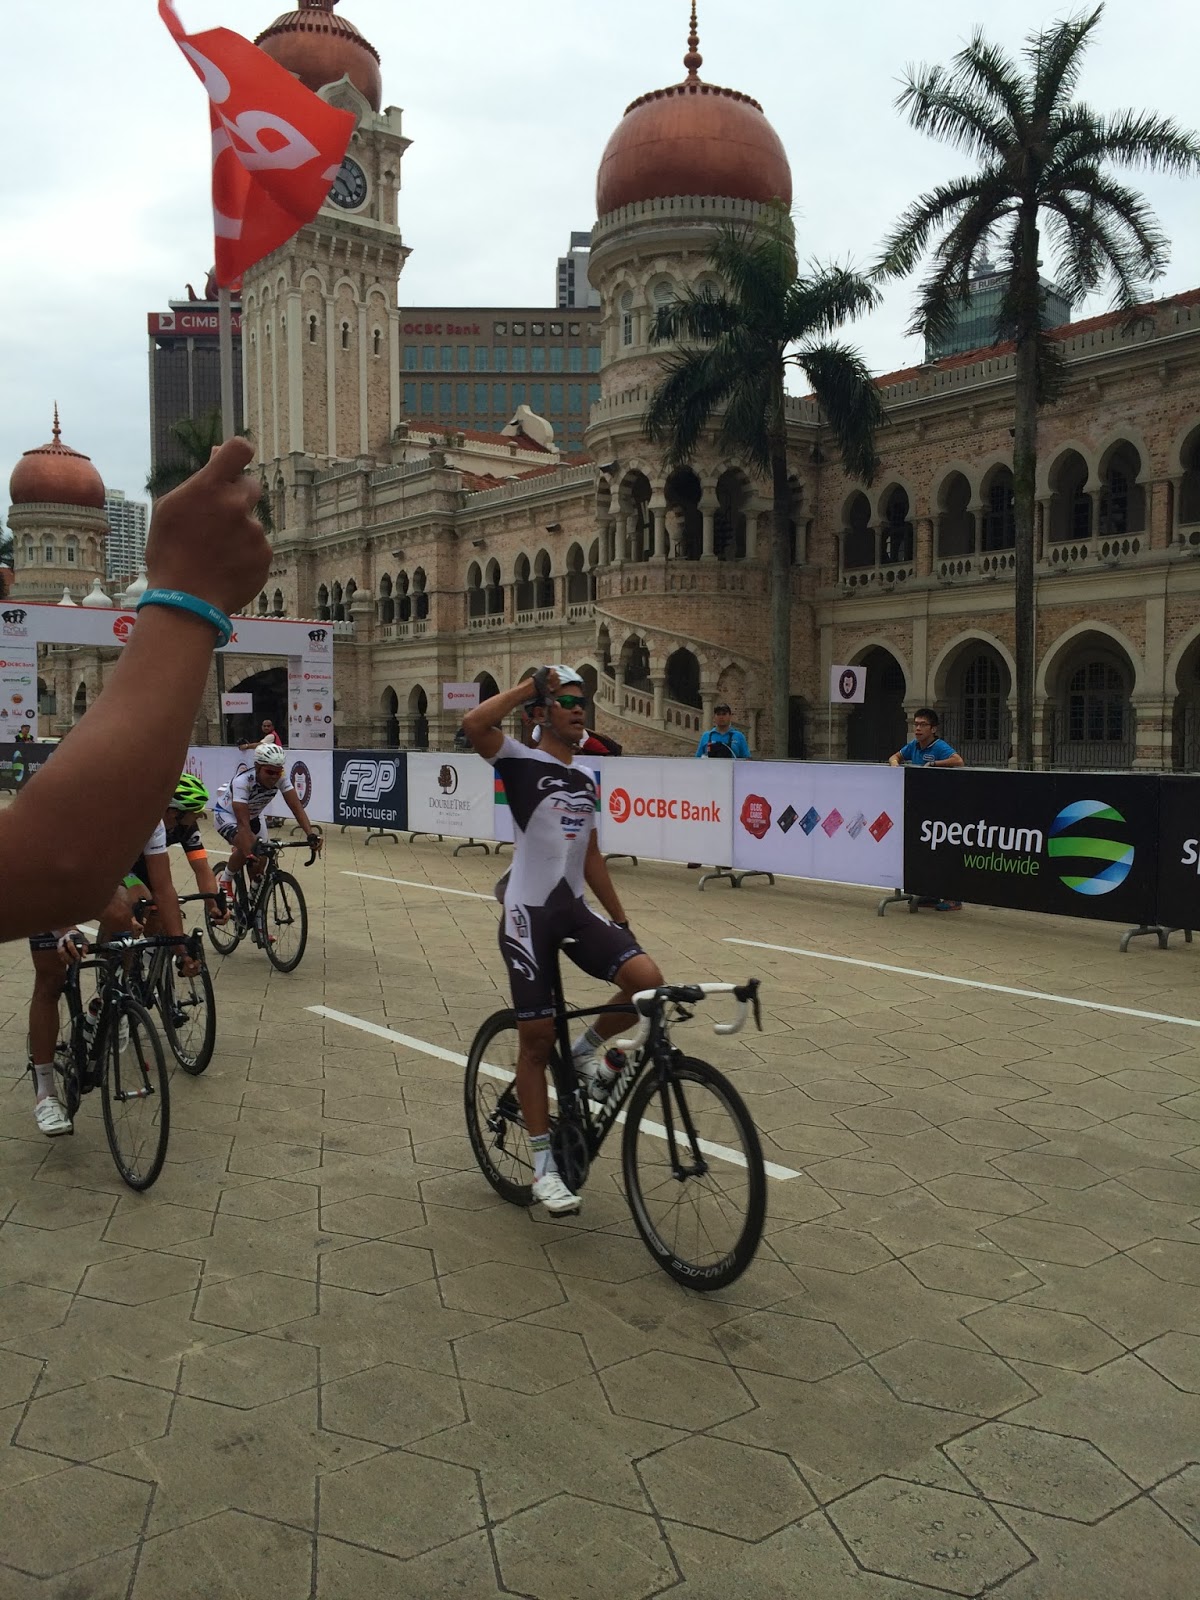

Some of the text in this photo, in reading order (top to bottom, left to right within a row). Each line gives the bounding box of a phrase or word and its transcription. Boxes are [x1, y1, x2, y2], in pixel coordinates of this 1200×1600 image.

[181, 316, 218, 328] CIMB
[403, 323, 480, 335] OCBC Bank
[339, 802, 398, 822] Sportswear
[633, 797, 721, 822] OCBC Bank
[919, 819, 1043, 854] spectrum
[963, 851, 1040, 876] worldwide
